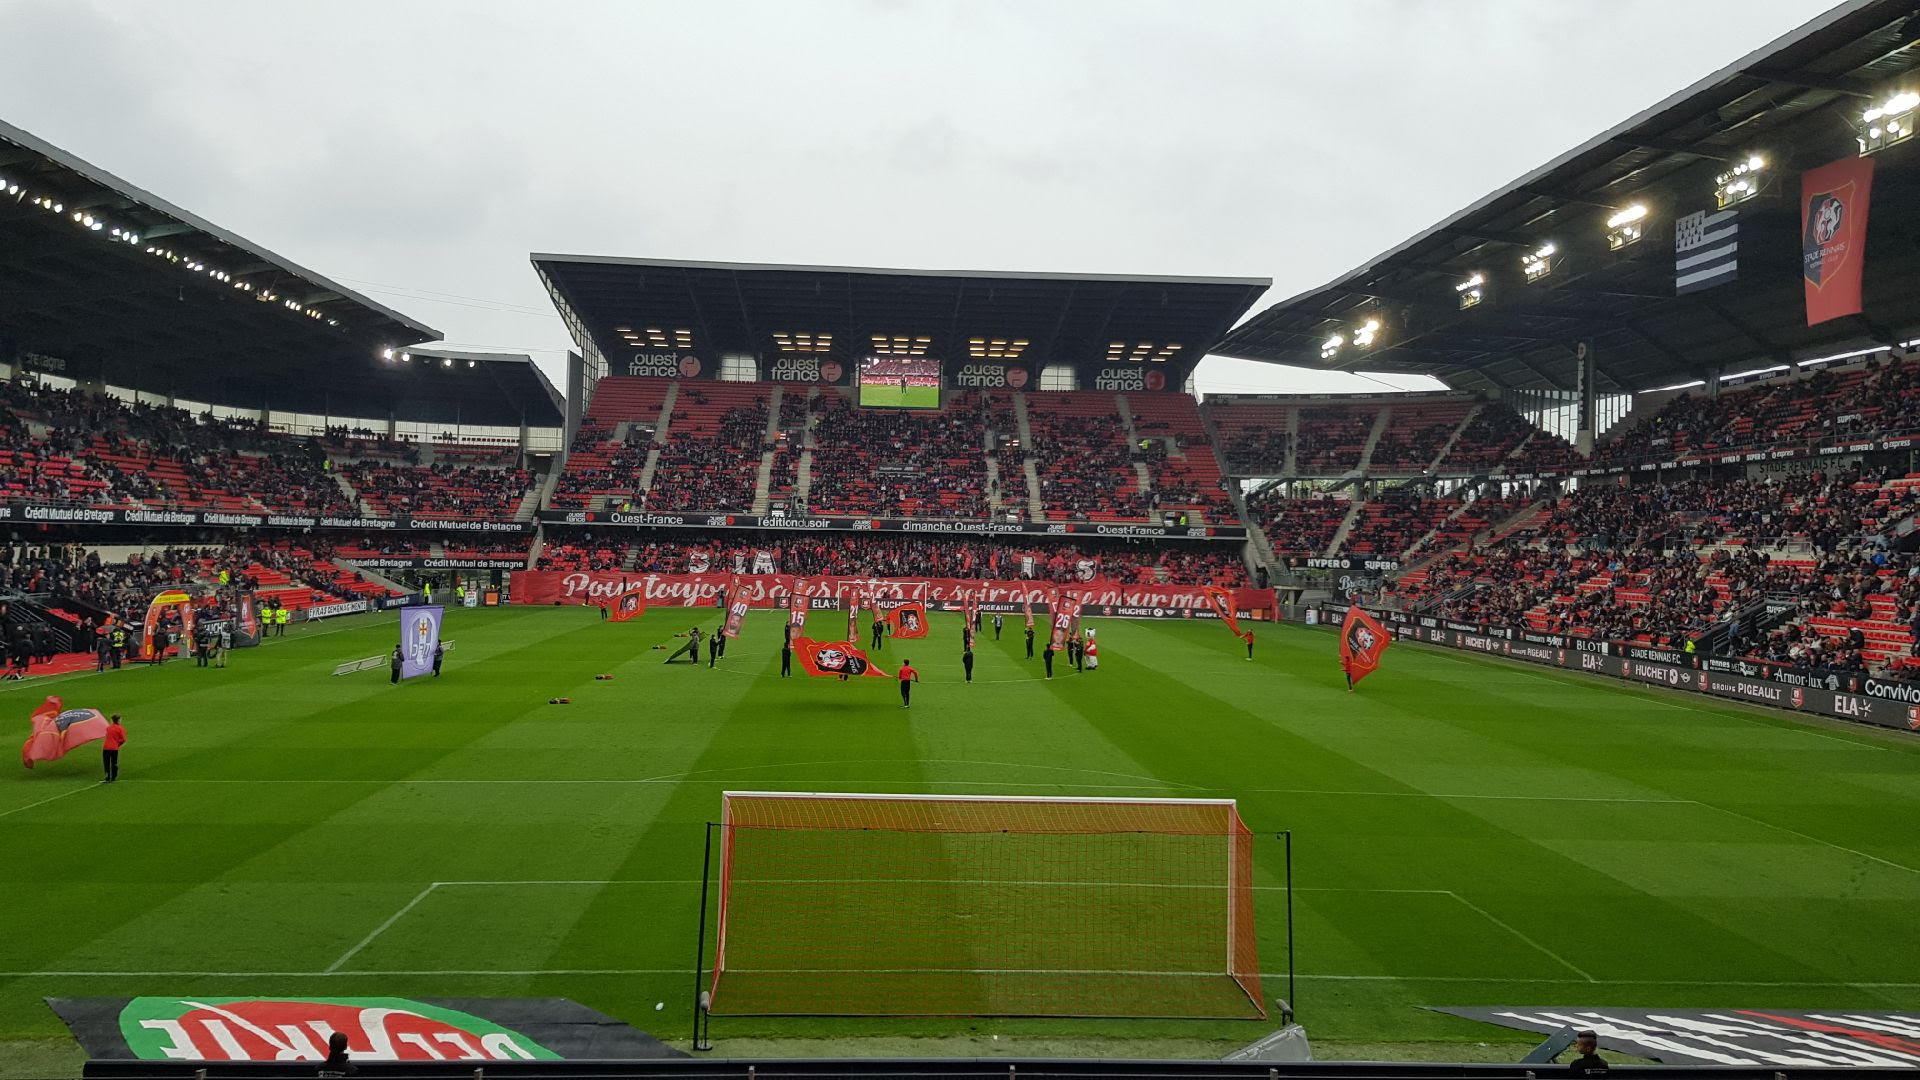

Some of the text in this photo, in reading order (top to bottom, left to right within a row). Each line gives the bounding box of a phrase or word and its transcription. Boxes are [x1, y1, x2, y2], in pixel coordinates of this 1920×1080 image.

[634, 352, 678, 366] ouest
[777, 357, 820, 371] ouest
[629, 362, 677, 377] france
[771, 367, 820, 381] france
[964, 364, 1005, 375] ouest
[1101, 367, 1143, 380] ouest
[957, 372, 1005, 387] france
[1095, 377, 1143, 391] france
[1760, 463, 1786, 474] STADE
[25, 506, 114, 524] Crédit Mutuel de Bretagne
[125, 510, 195, 525] Crédit Mutuel de Bretagne
[611, 512, 684, 524] Ouest-France
[333, 518, 351, 527] Mutuel
[352, 519, 361, 527] de
[361, 519, 396, 529] Bretagne
[410, 519, 522, 532] Crédit Mutuel de Bretagne
[902, 520, 1023, 532] dimanche Ouest-France
[1097, 525, 1165, 535] Ouest-France
[370, 559, 379, 567] de
[379, 559, 412, 568] Bretagne
[424, 559, 449, 567] Crédit
[489, 560, 524, 569] Bretagne
[1307, 559, 1341, 568] HYPER
[1364, 560, 1391, 570] SUPER
[562, 573, 642, 597] Pour
[731, 602, 748, 617] 40
[812, 599, 830, 608] ELA
[791, 611, 805, 626] 15
[1055, 613, 1070, 628] 26
[1465, 636, 1485, 649] HUCHET
[1576, 640, 1602, 653] BLOT
[1631, 649, 1648, 659] STADE
[1635, 664, 1669, 680] HUCHET
[1738, 682, 1782, 700] PIGEAULT
[1834, 695, 1859, 716] ELA
